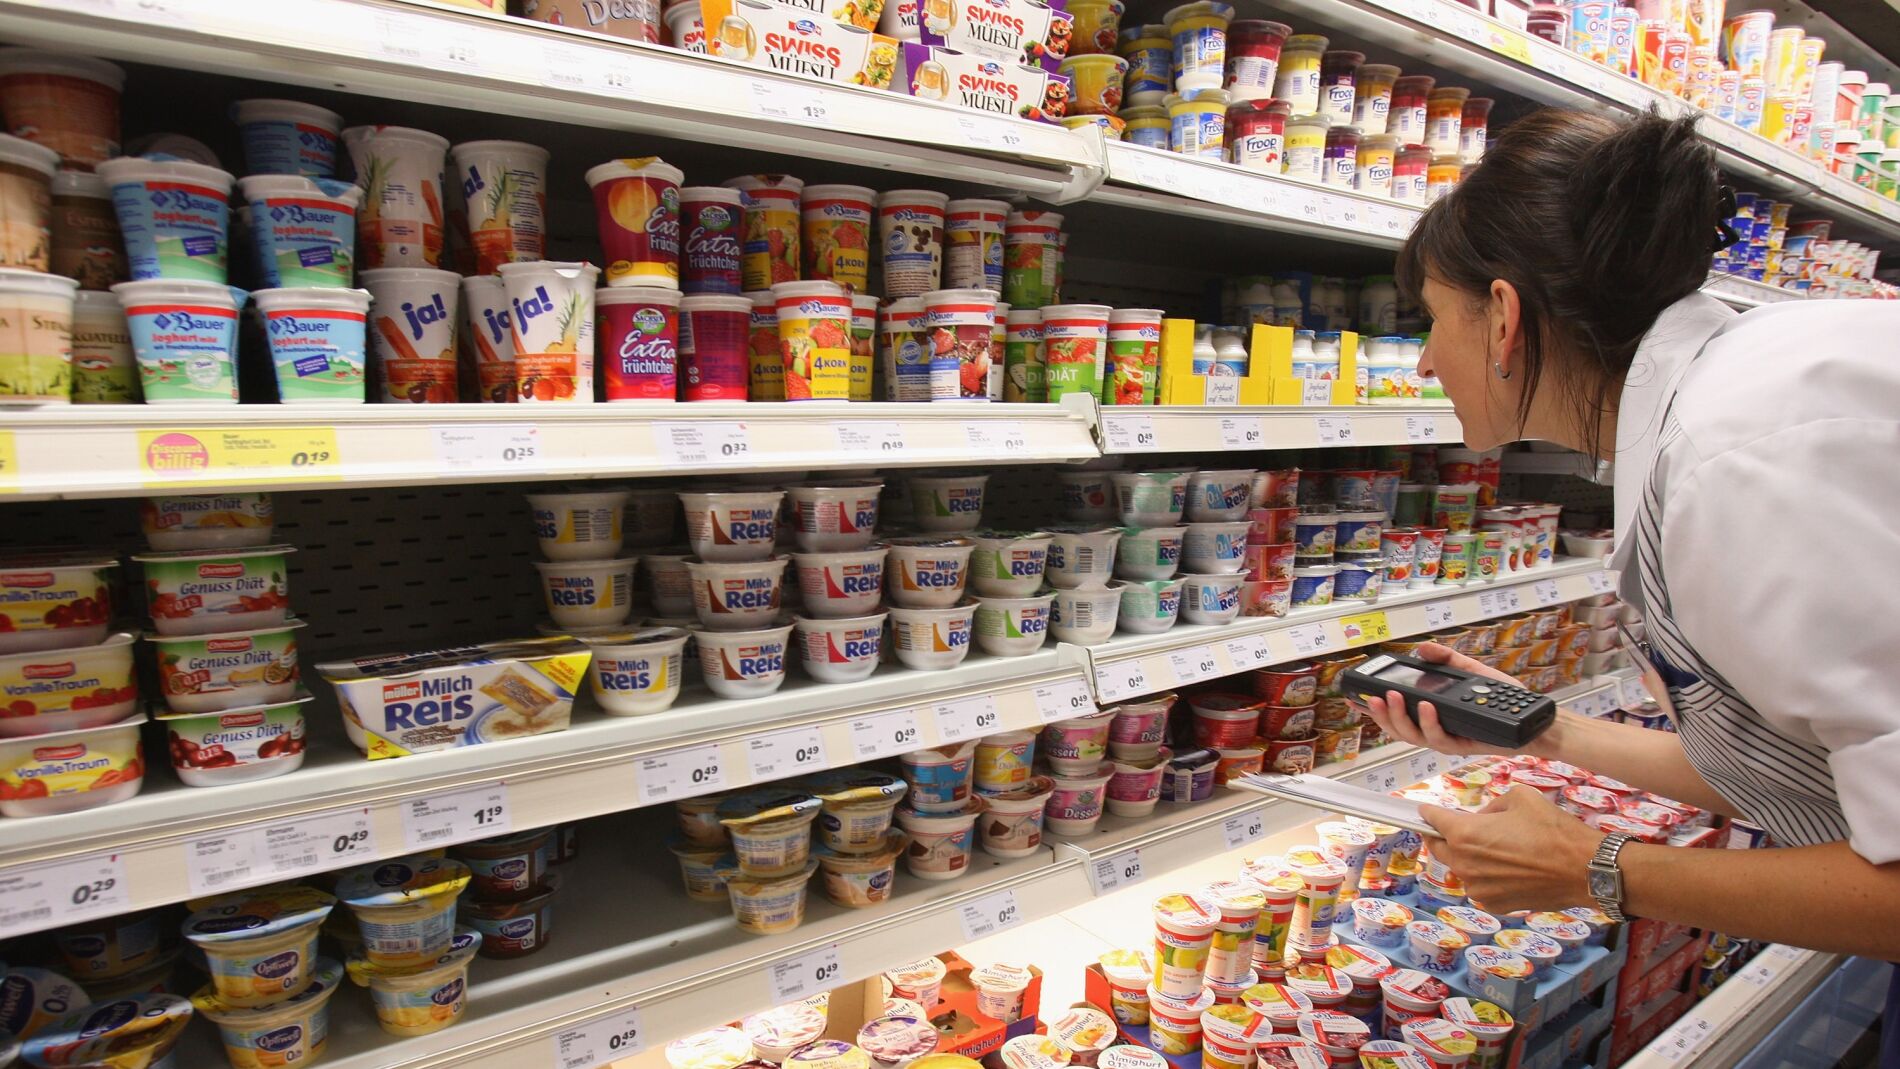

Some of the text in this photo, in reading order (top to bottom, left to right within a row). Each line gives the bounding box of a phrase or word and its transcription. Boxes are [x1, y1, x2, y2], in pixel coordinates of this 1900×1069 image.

[967, 5, 1024, 36] SWISS
[967, 22, 1019, 50] MÜESLI
[764, 32, 841, 68] SWISS
[958, 73, 1019, 102] SWISS
[960, 91, 1013, 115] MÜESLI
[1246, 137, 1277, 150] Froop
[464, 165, 485, 199] a!
[172, 190, 220, 213] Bauer
[832, 203, 862, 217] Bauer
[288, 205, 336, 223] Bauer
[645, 207, 679, 235] Extr
[273, 226, 314, 238] Joghurt
[686, 227, 740, 256] Extra
[689, 255, 740, 271] Früchtchen
[512, 286, 554, 335] ja!
[809, 300, 841, 313] Bauer
[171, 311, 225, 332] Bauer
[282, 316, 330, 335] Bauer
[401, 293, 447, 340] ja!
[484, 308, 510, 344] ja
[152, 333, 200, 345] Joghurt
[273, 337, 308, 347] Joghurt
[620, 330, 676, 358] Extra
[622, 359, 674, 375] Früchtchen
[1050, 368, 1079, 382] DIÄT
[154, 452, 204, 471] billig
[162, 497, 242, 512] Genuss Diät
[949, 498, 980, 512] Reis
[752, 510, 773, 521] Milch
[730, 521, 773, 539] Reis
[936, 560, 959, 571] Milch
[1012, 560, 1043, 576] Reis
[181, 577, 264, 596] Genuss Diät
[564, 577, 593, 588] Milch
[746, 578, 771, 590] Milch
[843, 575, 880, 593] Reis
[916, 570, 957, 587] Reis
[552, 589, 595, 606] Reis
[725, 589, 771, 608] Reis
[760, 643, 782, 656] Milch
[189, 650, 272, 670] Genuss Diät
[617, 660, 649, 672] Milch
[740, 655, 782, 675] Reis
[384, 675, 473, 699] müller Milch
[601, 671, 650, 690] Reis
[385, 694, 473, 732] Reis
[976, 713, 995, 727] 0.49
[203, 724, 285, 745] Genuss Diät
[895, 728, 916, 743] 0.49
[796, 746, 819, 762] 0.49
[692, 766, 718, 783] 0.49
[474, 806, 503, 824] 1.19
[333, 830, 368, 852] 0.49
[72, 878, 115, 905] 0.29
[816, 963, 838, 981] 0.49
[981, 966, 1028, 982] Almighurt
[1060, 1012, 1095, 1041] Almighurt
[609, 1029, 636, 1050] 0.49
[1108, 1053, 1162, 1069] Almighurt
